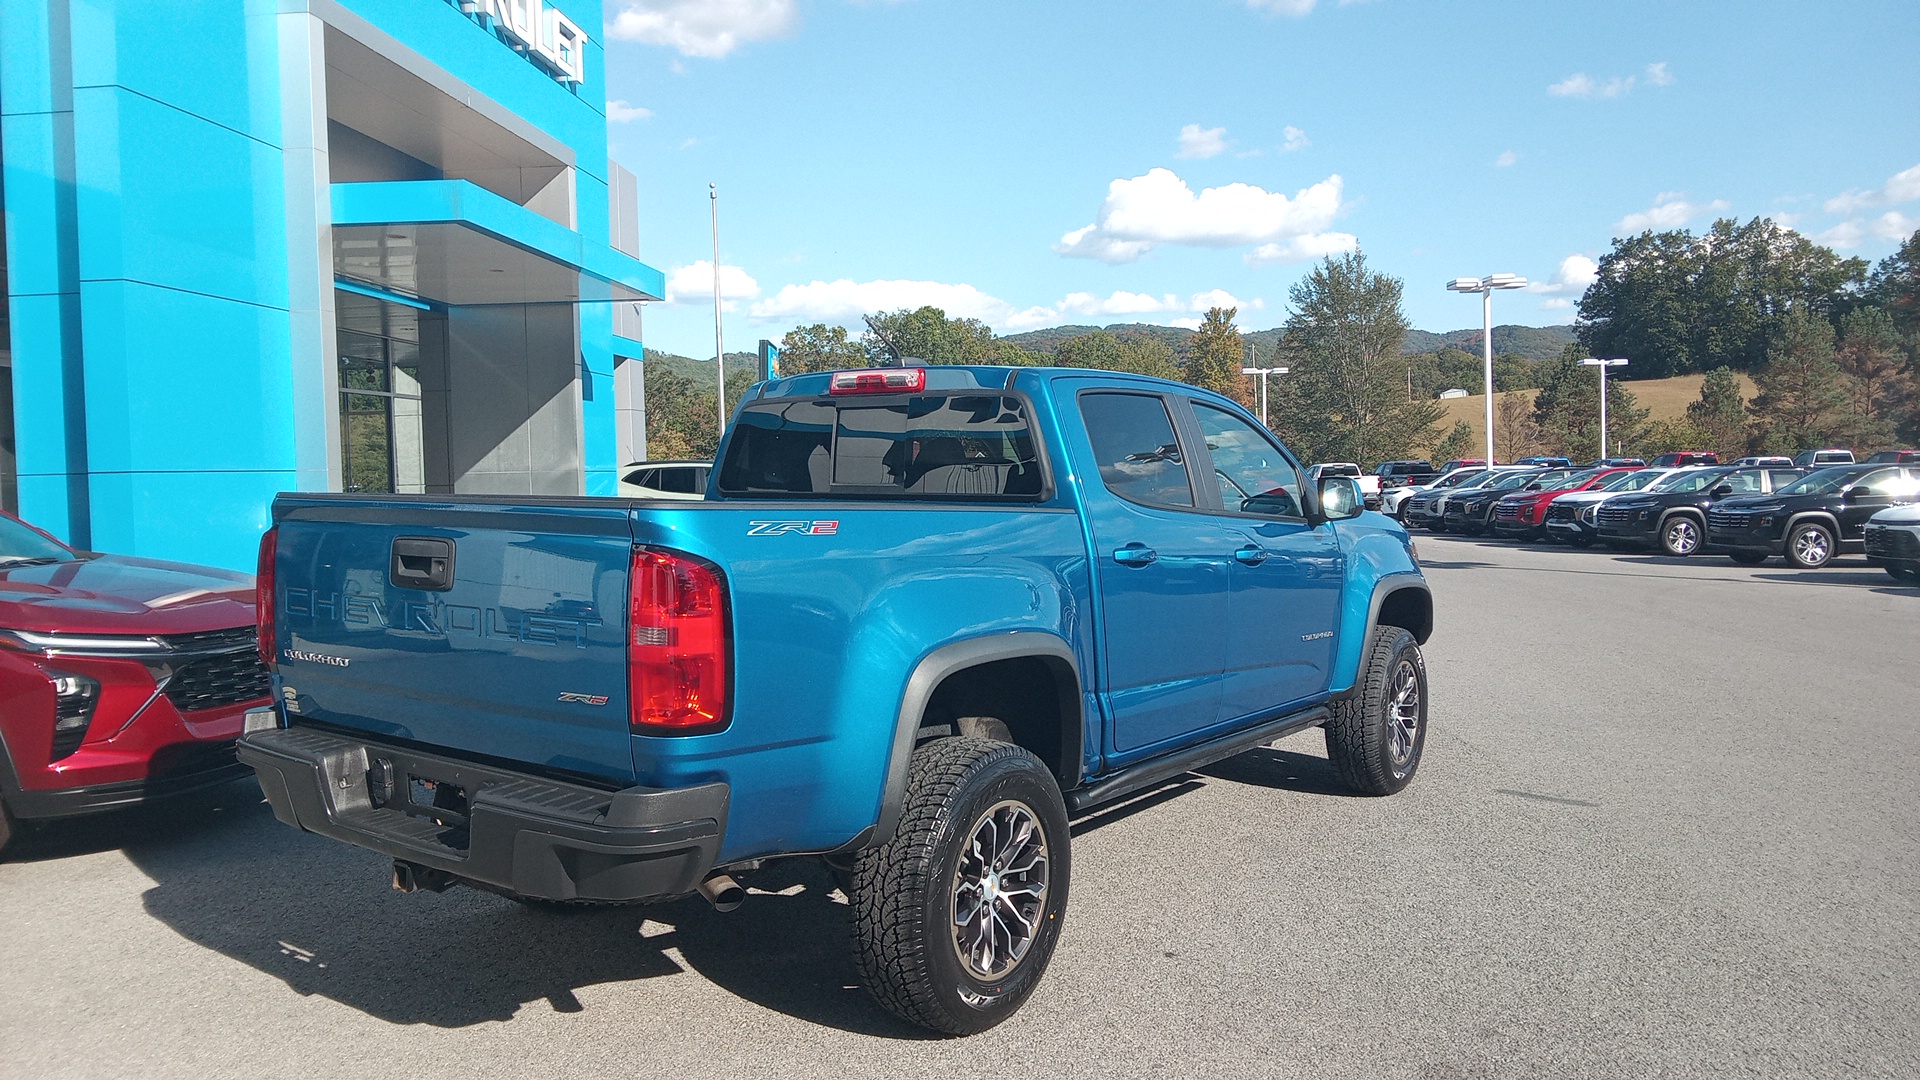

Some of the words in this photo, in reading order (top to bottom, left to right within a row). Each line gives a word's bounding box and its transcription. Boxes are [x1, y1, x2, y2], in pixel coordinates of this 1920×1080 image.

[746, 520, 839, 536] ZR2
[285, 587, 603, 649] CHEVROLET
[557, 691, 609, 706] ZR2
